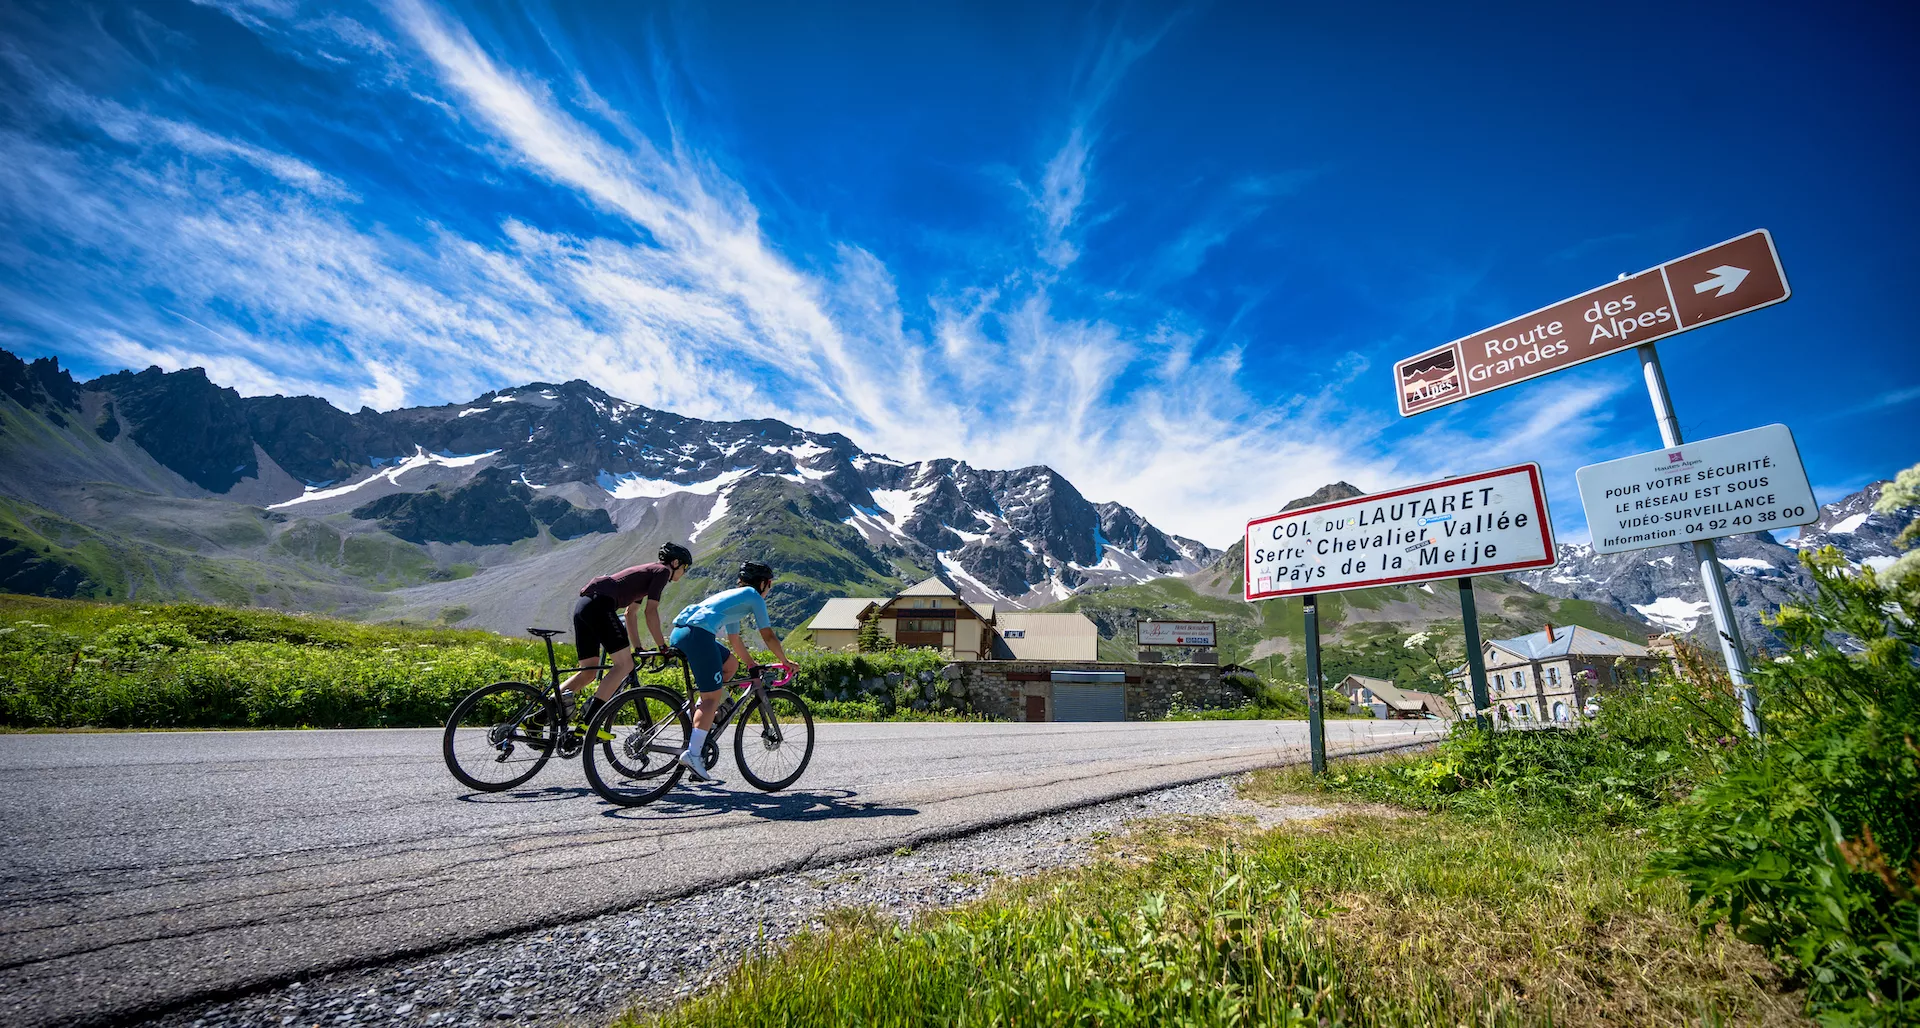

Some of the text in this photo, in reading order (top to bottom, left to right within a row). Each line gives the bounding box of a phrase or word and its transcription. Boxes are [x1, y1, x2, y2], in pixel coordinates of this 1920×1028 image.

[1468, 305, 1671, 381] Grandes Alpes
[1484, 294, 1637, 358] Route des
[1412, 381, 1453, 401] Alpes
[1606, 484, 1640, 499] POUR
[1646, 474, 1691, 490] VOTRE
[1697, 456, 1776, 480] SÉCURITÉ,
[1654, 464, 1680, 472] Hautes
[1272, 520, 1311, 540] COL
[1325, 519, 1345, 532] DU
[1359, 487, 1494, 526] LAUTARET
[1616, 477, 1769, 513] LE RÉSEAU EST SOUS
[1619, 494, 1776, 529] VIDÉO-SURVEILLANCE
[1254, 547, 1305, 564] Serre
[1317, 528, 1427, 555] Chevalier
[1443, 511, 1528, 537] Vallée
[1604, 529, 1676, 547] Information
[1685, 522, 1704, 534] 04
[1709, 519, 1727, 530] 92
[1732, 514, 1752, 526] 40
[1758, 511, 1776, 522] 38
[1783, 506, 1805, 518] 00
[1277, 565, 1326, 583] Pays
[1341, 558, 1366, 575] de
[1382, 554, 1402, 570] la
[1419, 541, 1497, 566] Meije
